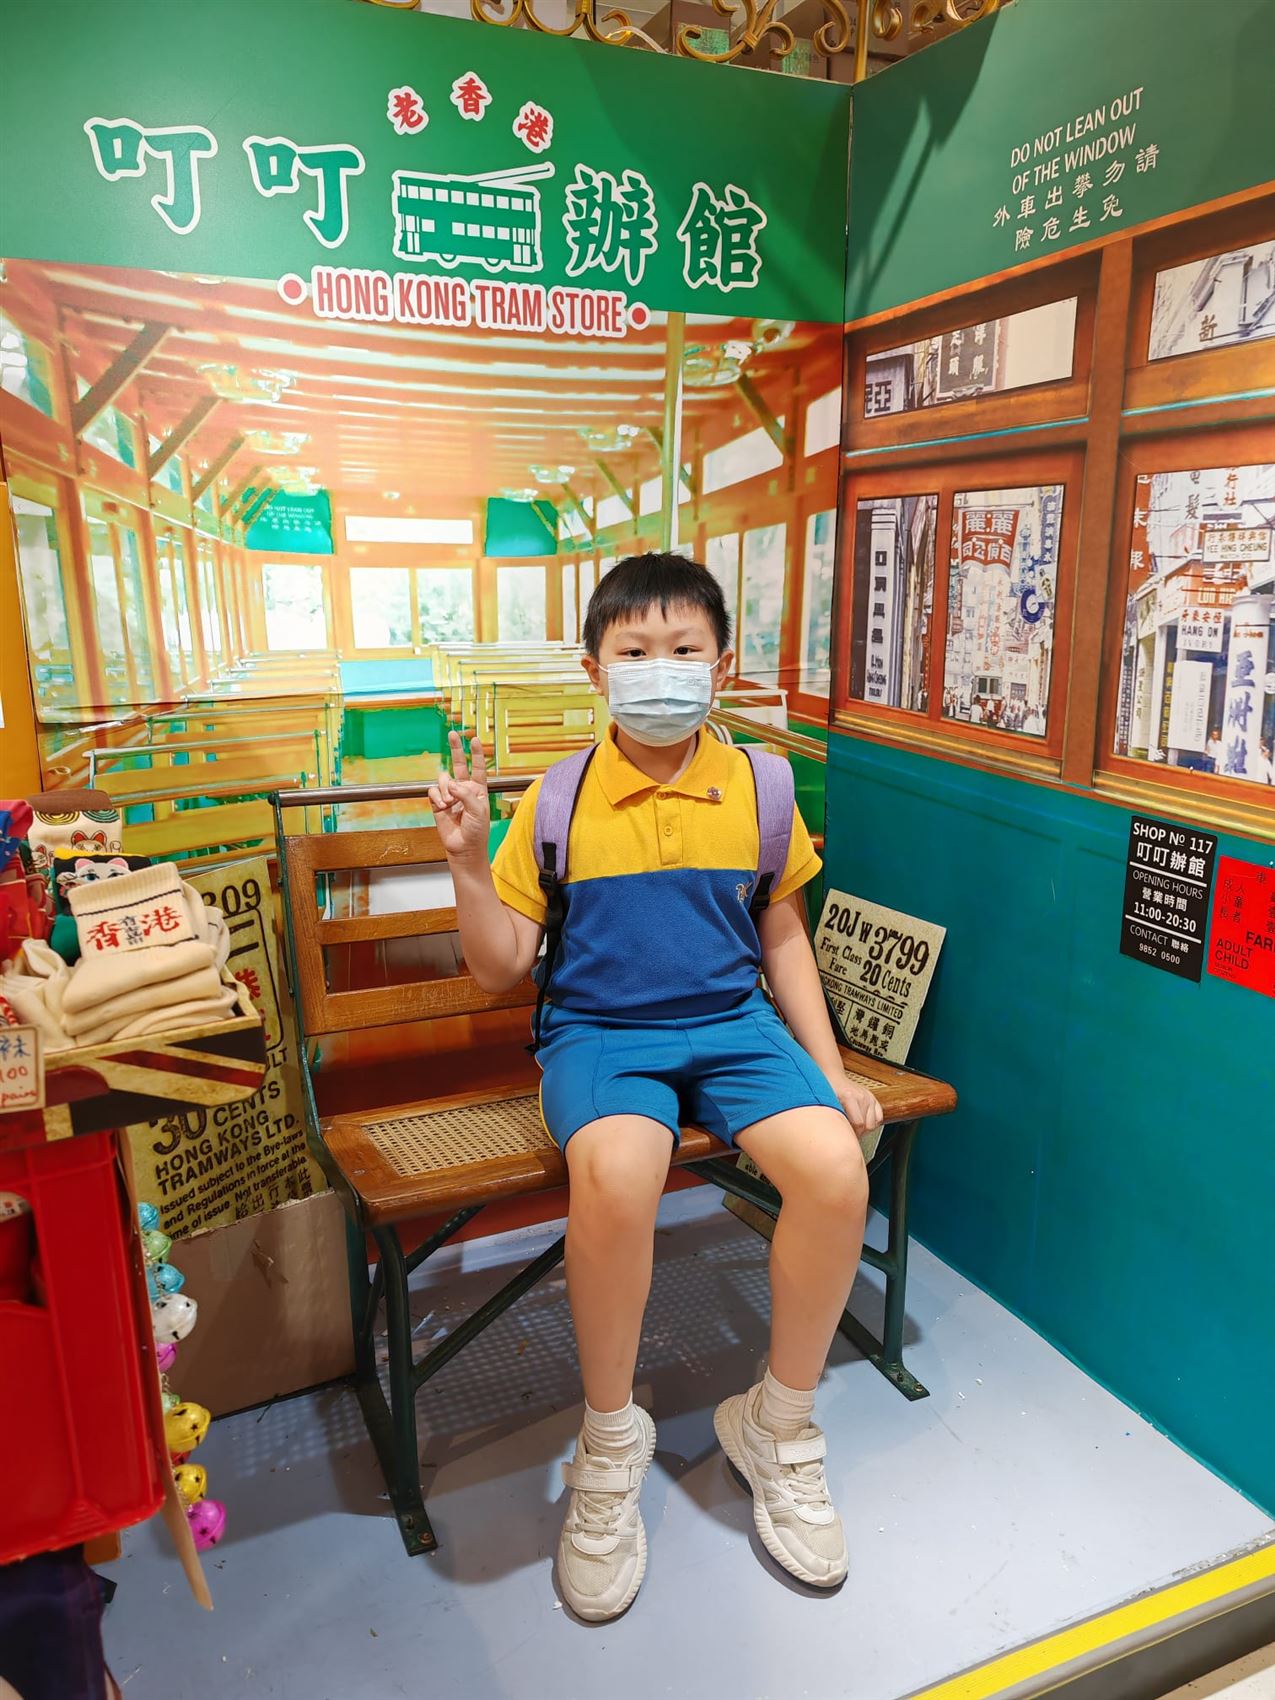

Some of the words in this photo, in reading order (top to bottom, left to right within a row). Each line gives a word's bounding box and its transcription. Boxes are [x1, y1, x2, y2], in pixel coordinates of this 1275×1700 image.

[1011, 144, 1030, 168] DO
[1034, 127, 1062, 157] NOT
[1066, 106, 1105, 142] LEAN
[1111, 87, 1144, 120] OUT
[1012, 171, 1030, 194] OF
[1034, 157, 1060, 185] THE
[1065, 123, 1136, 173] WINDOW
[315, 271, 389, 317] HONG
[399, 278, 467, 322] KONG
[475, 284, 543, 329] TRAM
[551, 290, 623, 332] STORE
[1133, 822, 1166, 842] SHOP
[1190, 837, 1213, 854] 117
[1133, 870, 1169, 890] OPENING
[1172, 882, 1203, 900] HOURS
[1142, 887, 1187, 912] 營業時間
[1134, 901, 1196, 933] 11:00-20:30
[869, 926, 929, 976] 3799
[1130, 924, 1168, 946] CONTACT
[1216, 938, 1253, 957] ADULT
[1246, 931, 1275, 952] FAR
[820, 937, 840, 955] First
[842, 946, 862, 966] Class
[829, 957, 848, 976] Fare
[1139, 943, 1157, 956] 9852
[1161, 951, 1181, 965] 0500
[1215, 949, 1249, 970] CHILD
[860, 960, 882, 987] 20
[881, 970, 912, 998] Cents
[843, 983, 876, 1007] TRAMWAYS
[877, 997, 903, 1019] LIMITED
[155, 1139, 212, 1180] HONG
[218, 1110, 269, 1147] KONG
[158, 1131, 262, 1196] TRAMWAYS
[197, 1168, 234, 1195] subject
[236, 1161, 244, 1171] to
[247, 1151, 262, 1166] the
[163, 1212, 184, 1230] and
[187, 1175, 245, 1216] Regulations
[247, 1169, 256, 1181] in
[257, 1158, 280, 1179] force
[282, 1150, 290, 1161] at
[292, 1143, 306, 1156] the
[168, 1225, 189, 1240] ime
[192, 1215, 201, 1229] of
